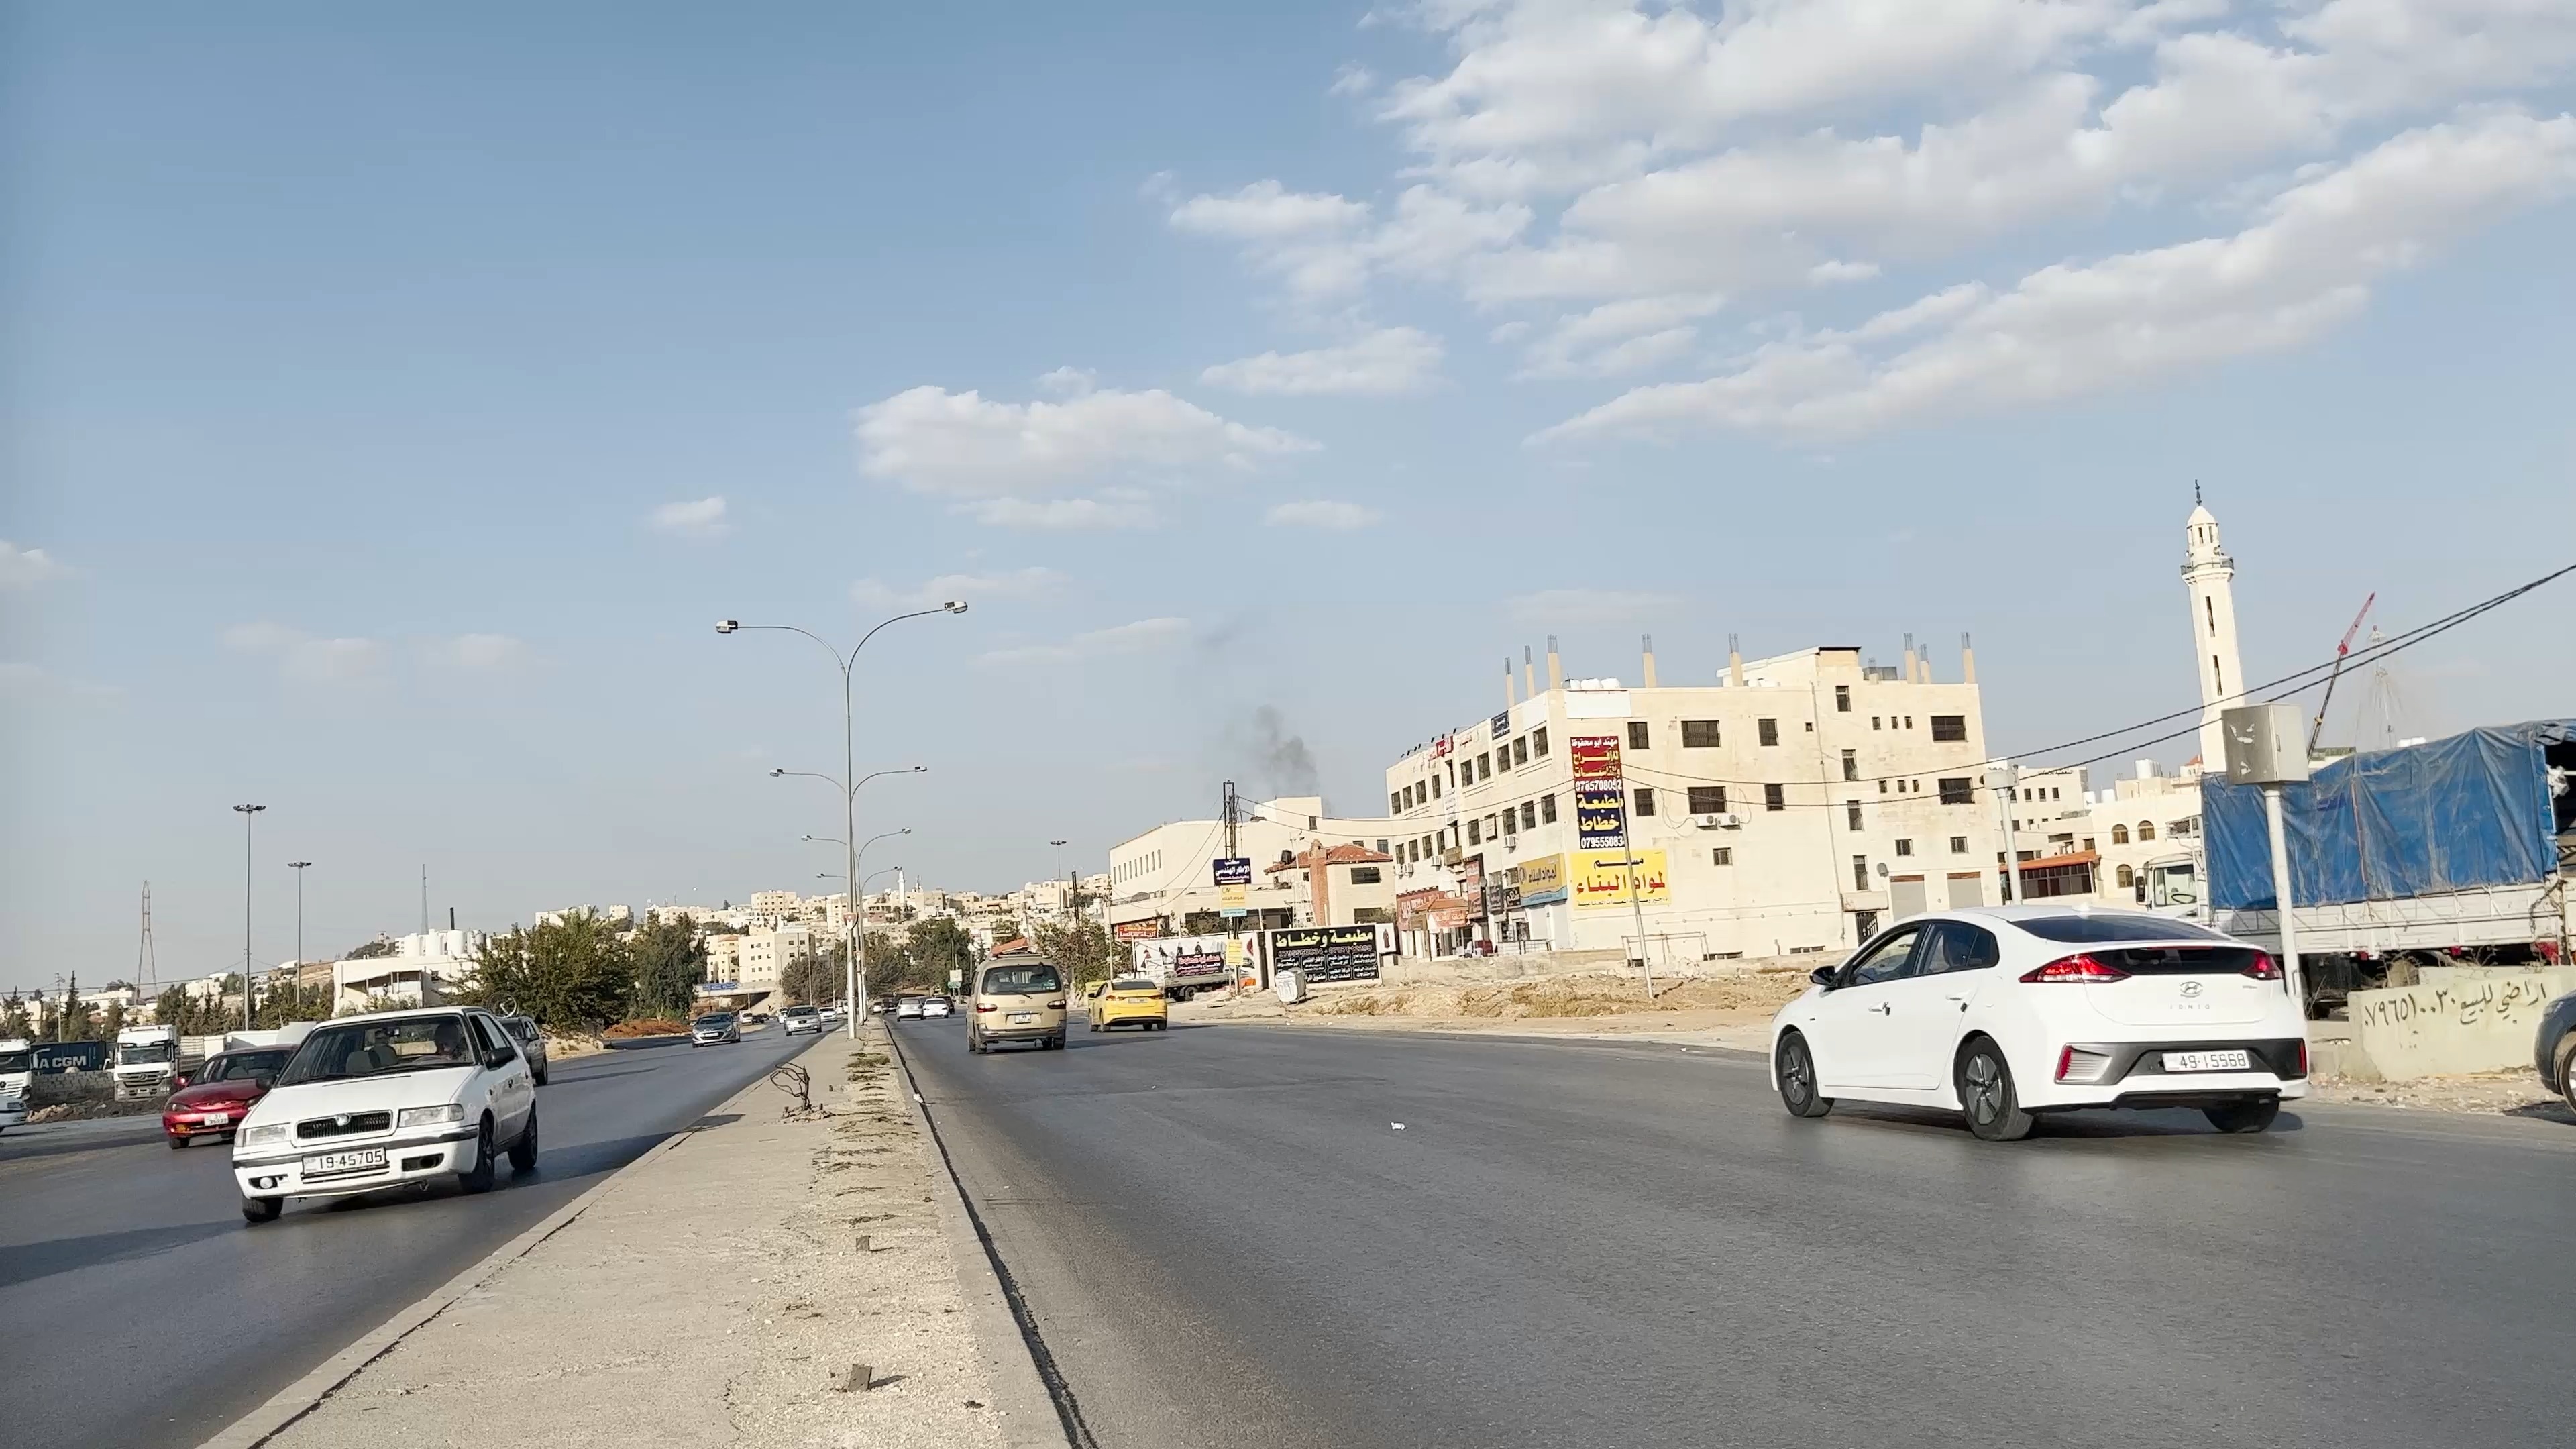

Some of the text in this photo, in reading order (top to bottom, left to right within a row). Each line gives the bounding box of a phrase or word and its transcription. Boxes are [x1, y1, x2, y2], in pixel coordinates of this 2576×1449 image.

[1580, 814, 1620, 832] خطاط
[1576, 873, 1627, 897] البناء
[1275, 928, 1374, 948] مطبعة وخطاط
[2459, 983, 2494, 1026] للبيع
[52, 1055, 87, 1068] CGM
